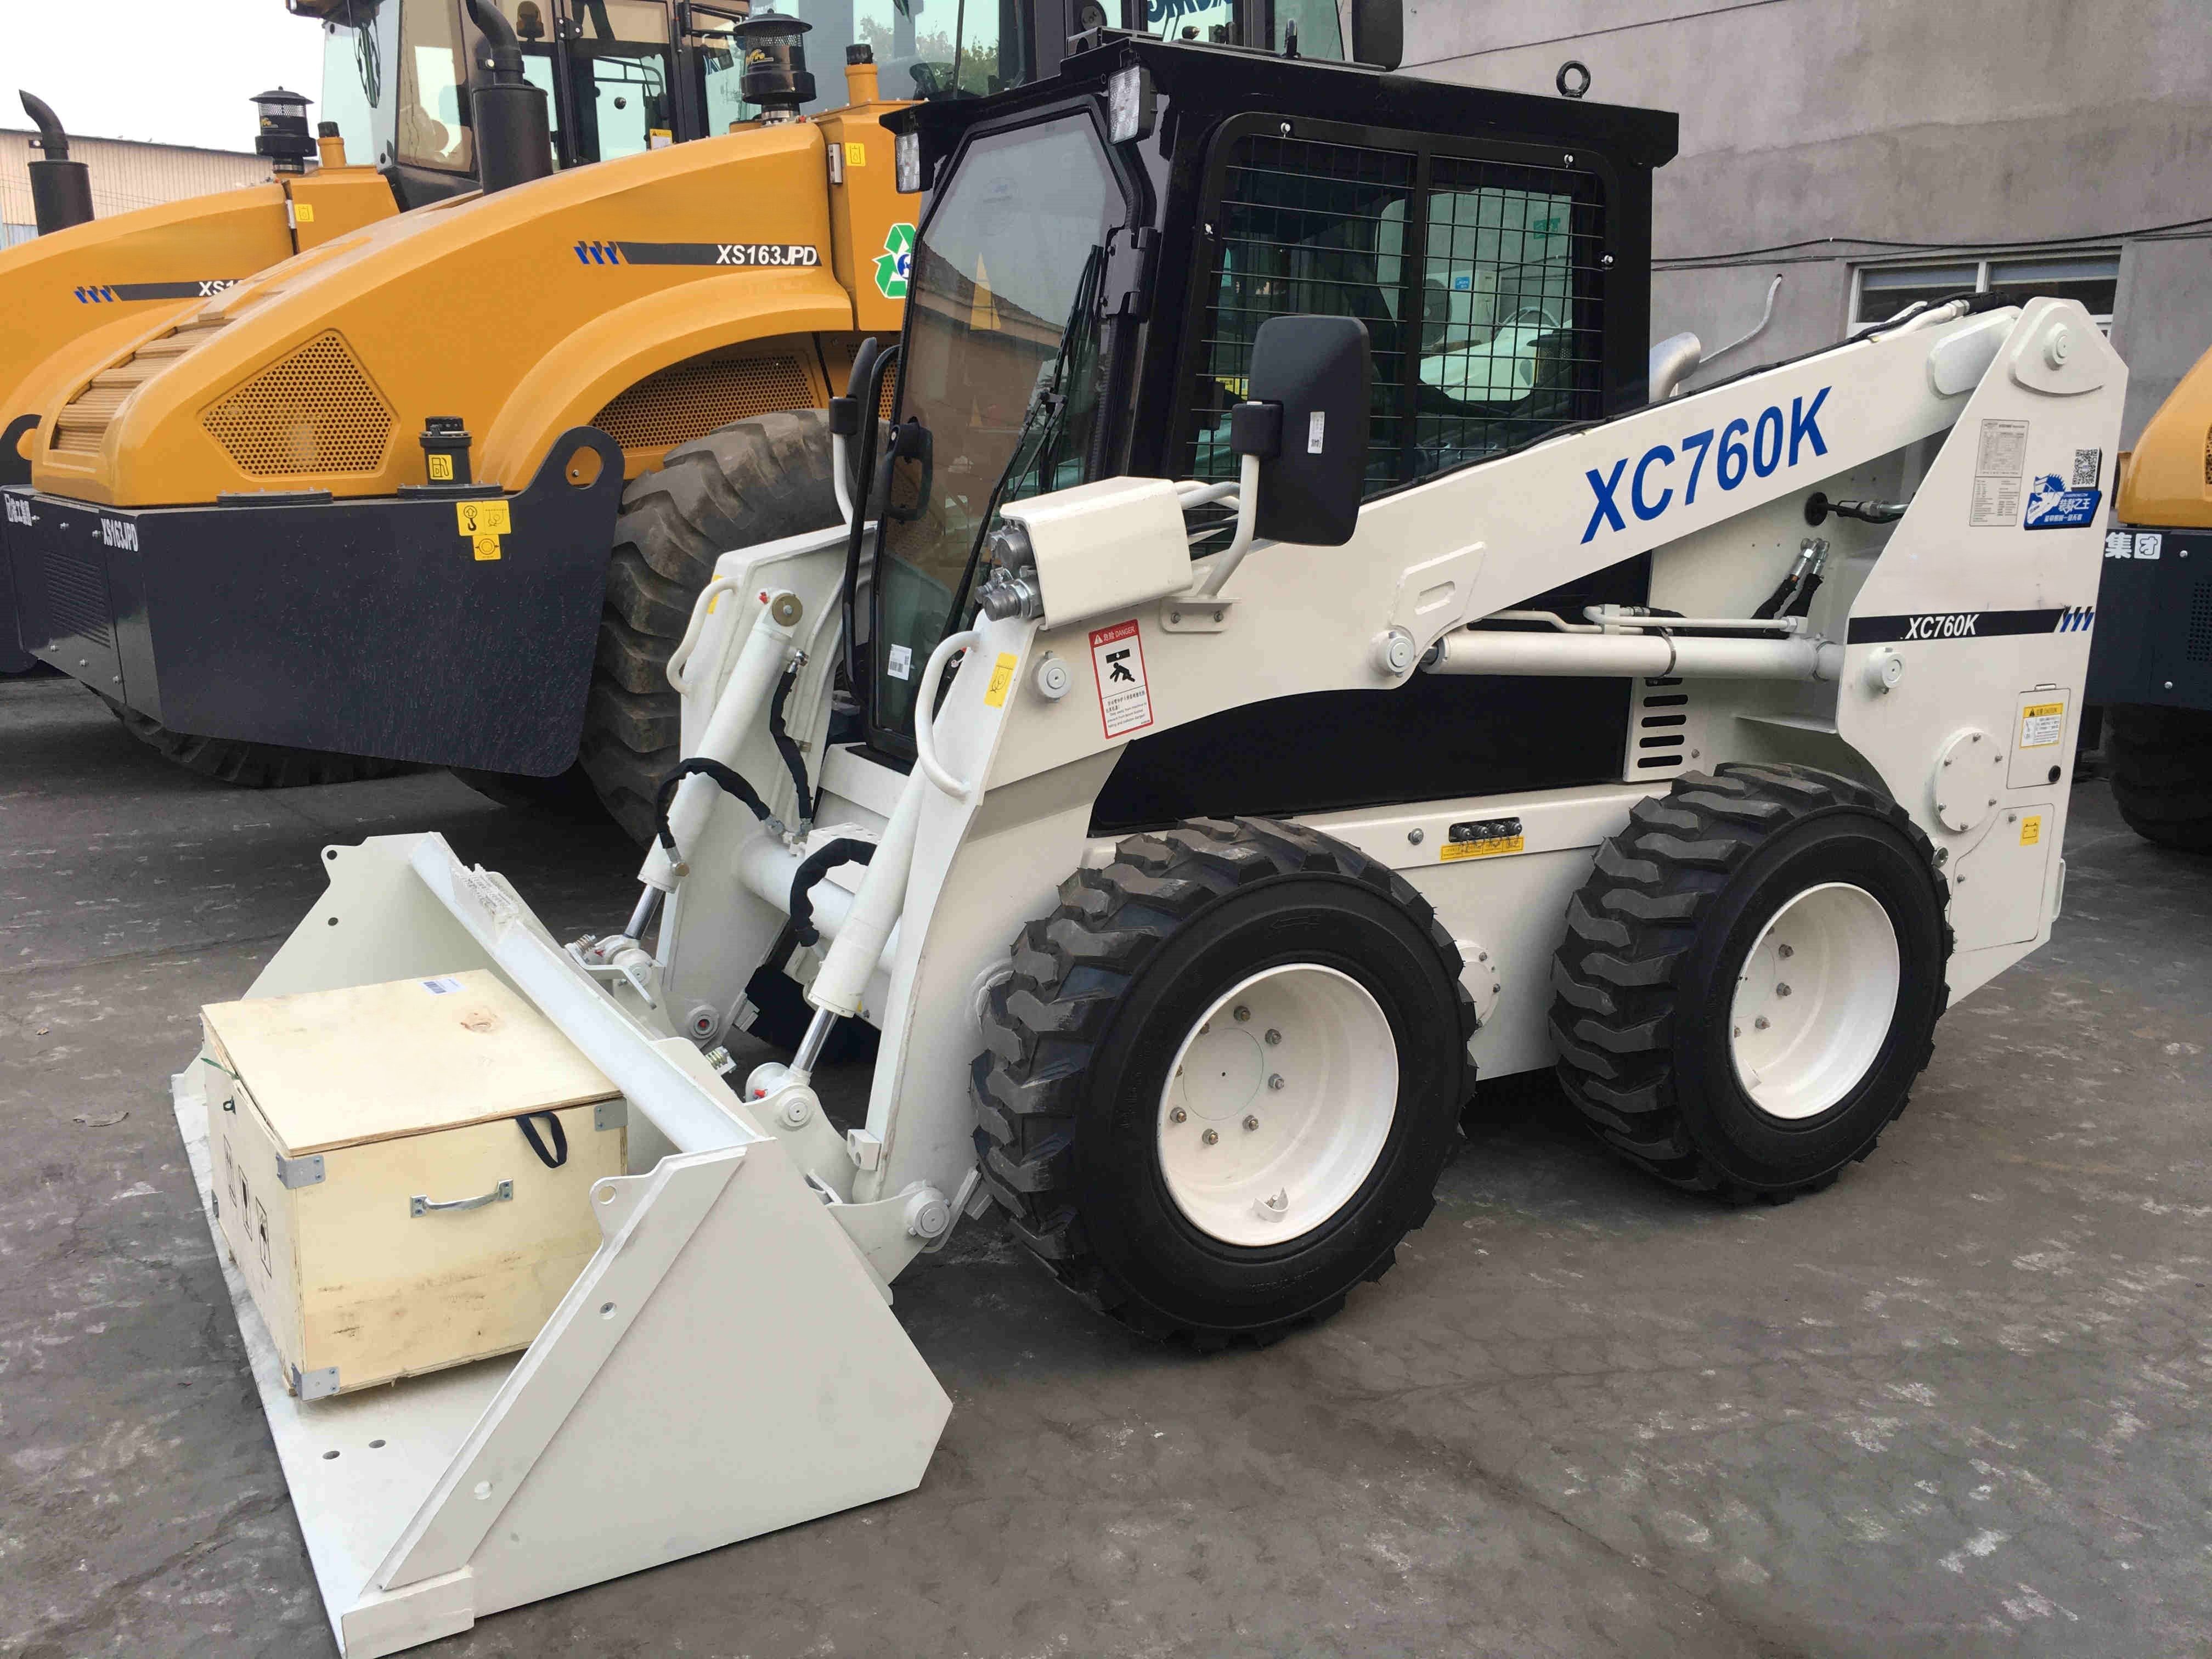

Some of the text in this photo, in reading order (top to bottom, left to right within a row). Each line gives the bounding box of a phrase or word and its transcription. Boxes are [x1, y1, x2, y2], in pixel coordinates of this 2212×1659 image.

[716, 245, 817, 266] XS163JPD
[1581, 386, 1832, 544] XC760K
[101, 518, 138, 552] XS163JPD
[2105, 532, 2162, 560] 集团
[1115, 626, 1136, 638] DANGER
[1904, 614, 1980, 640] XC760K
